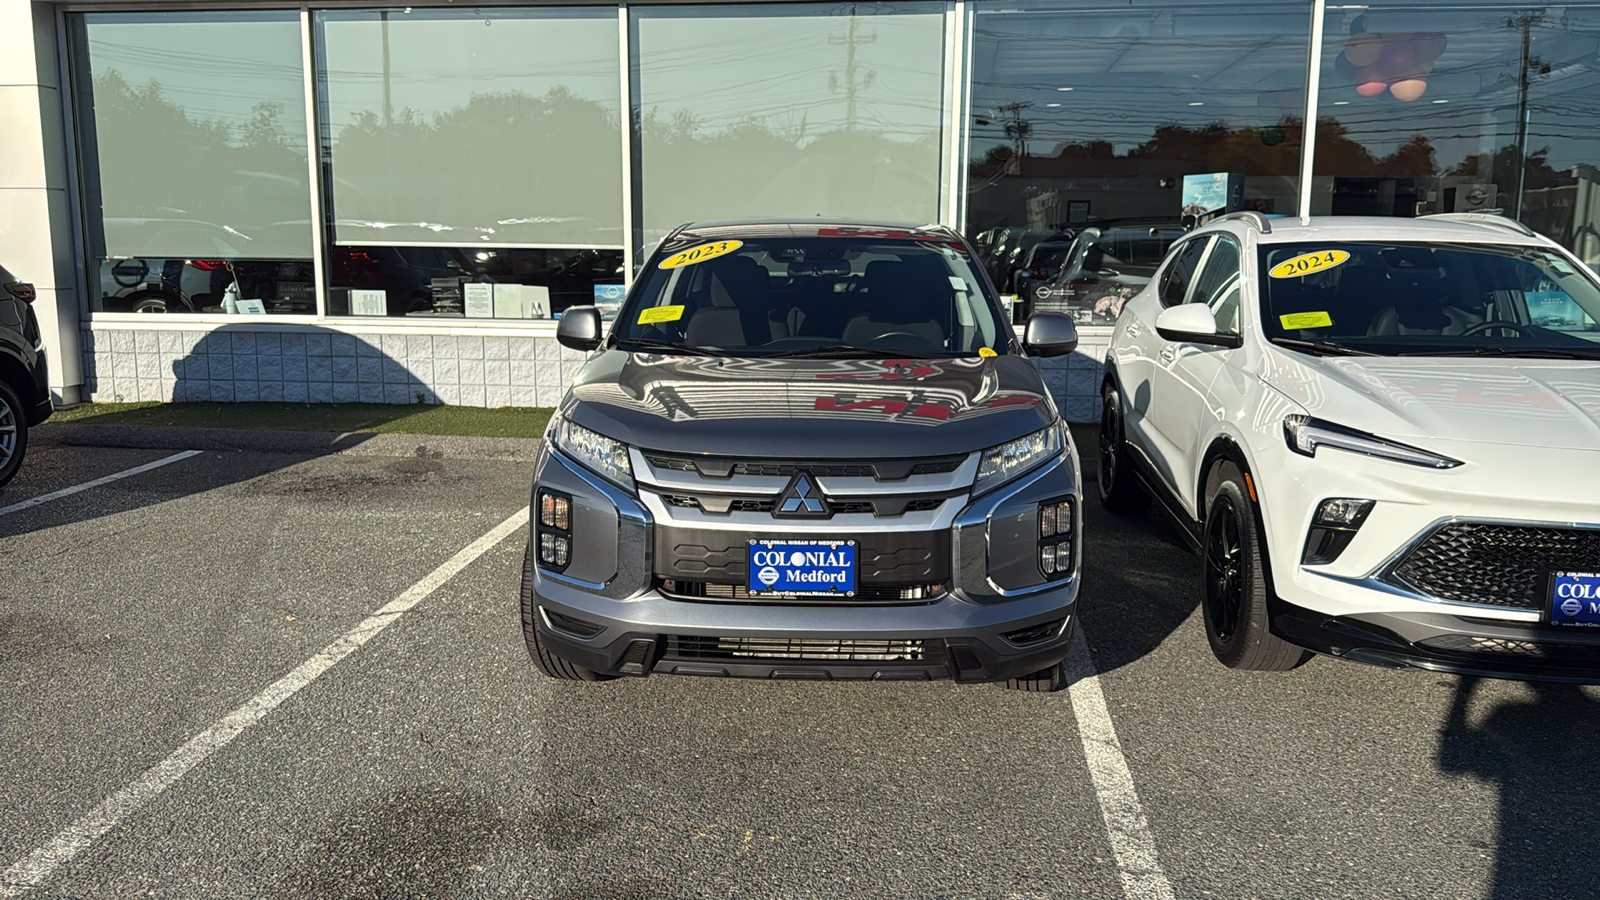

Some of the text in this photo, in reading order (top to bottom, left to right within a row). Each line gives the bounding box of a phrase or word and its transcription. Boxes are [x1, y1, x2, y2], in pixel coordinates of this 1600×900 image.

[674, 242, 728, 266] 2023
[1284, 252, 1335, 275] 2024
[753, 551, 851, 567] COLONIAL
[786, 569, 846, 583] Medford
